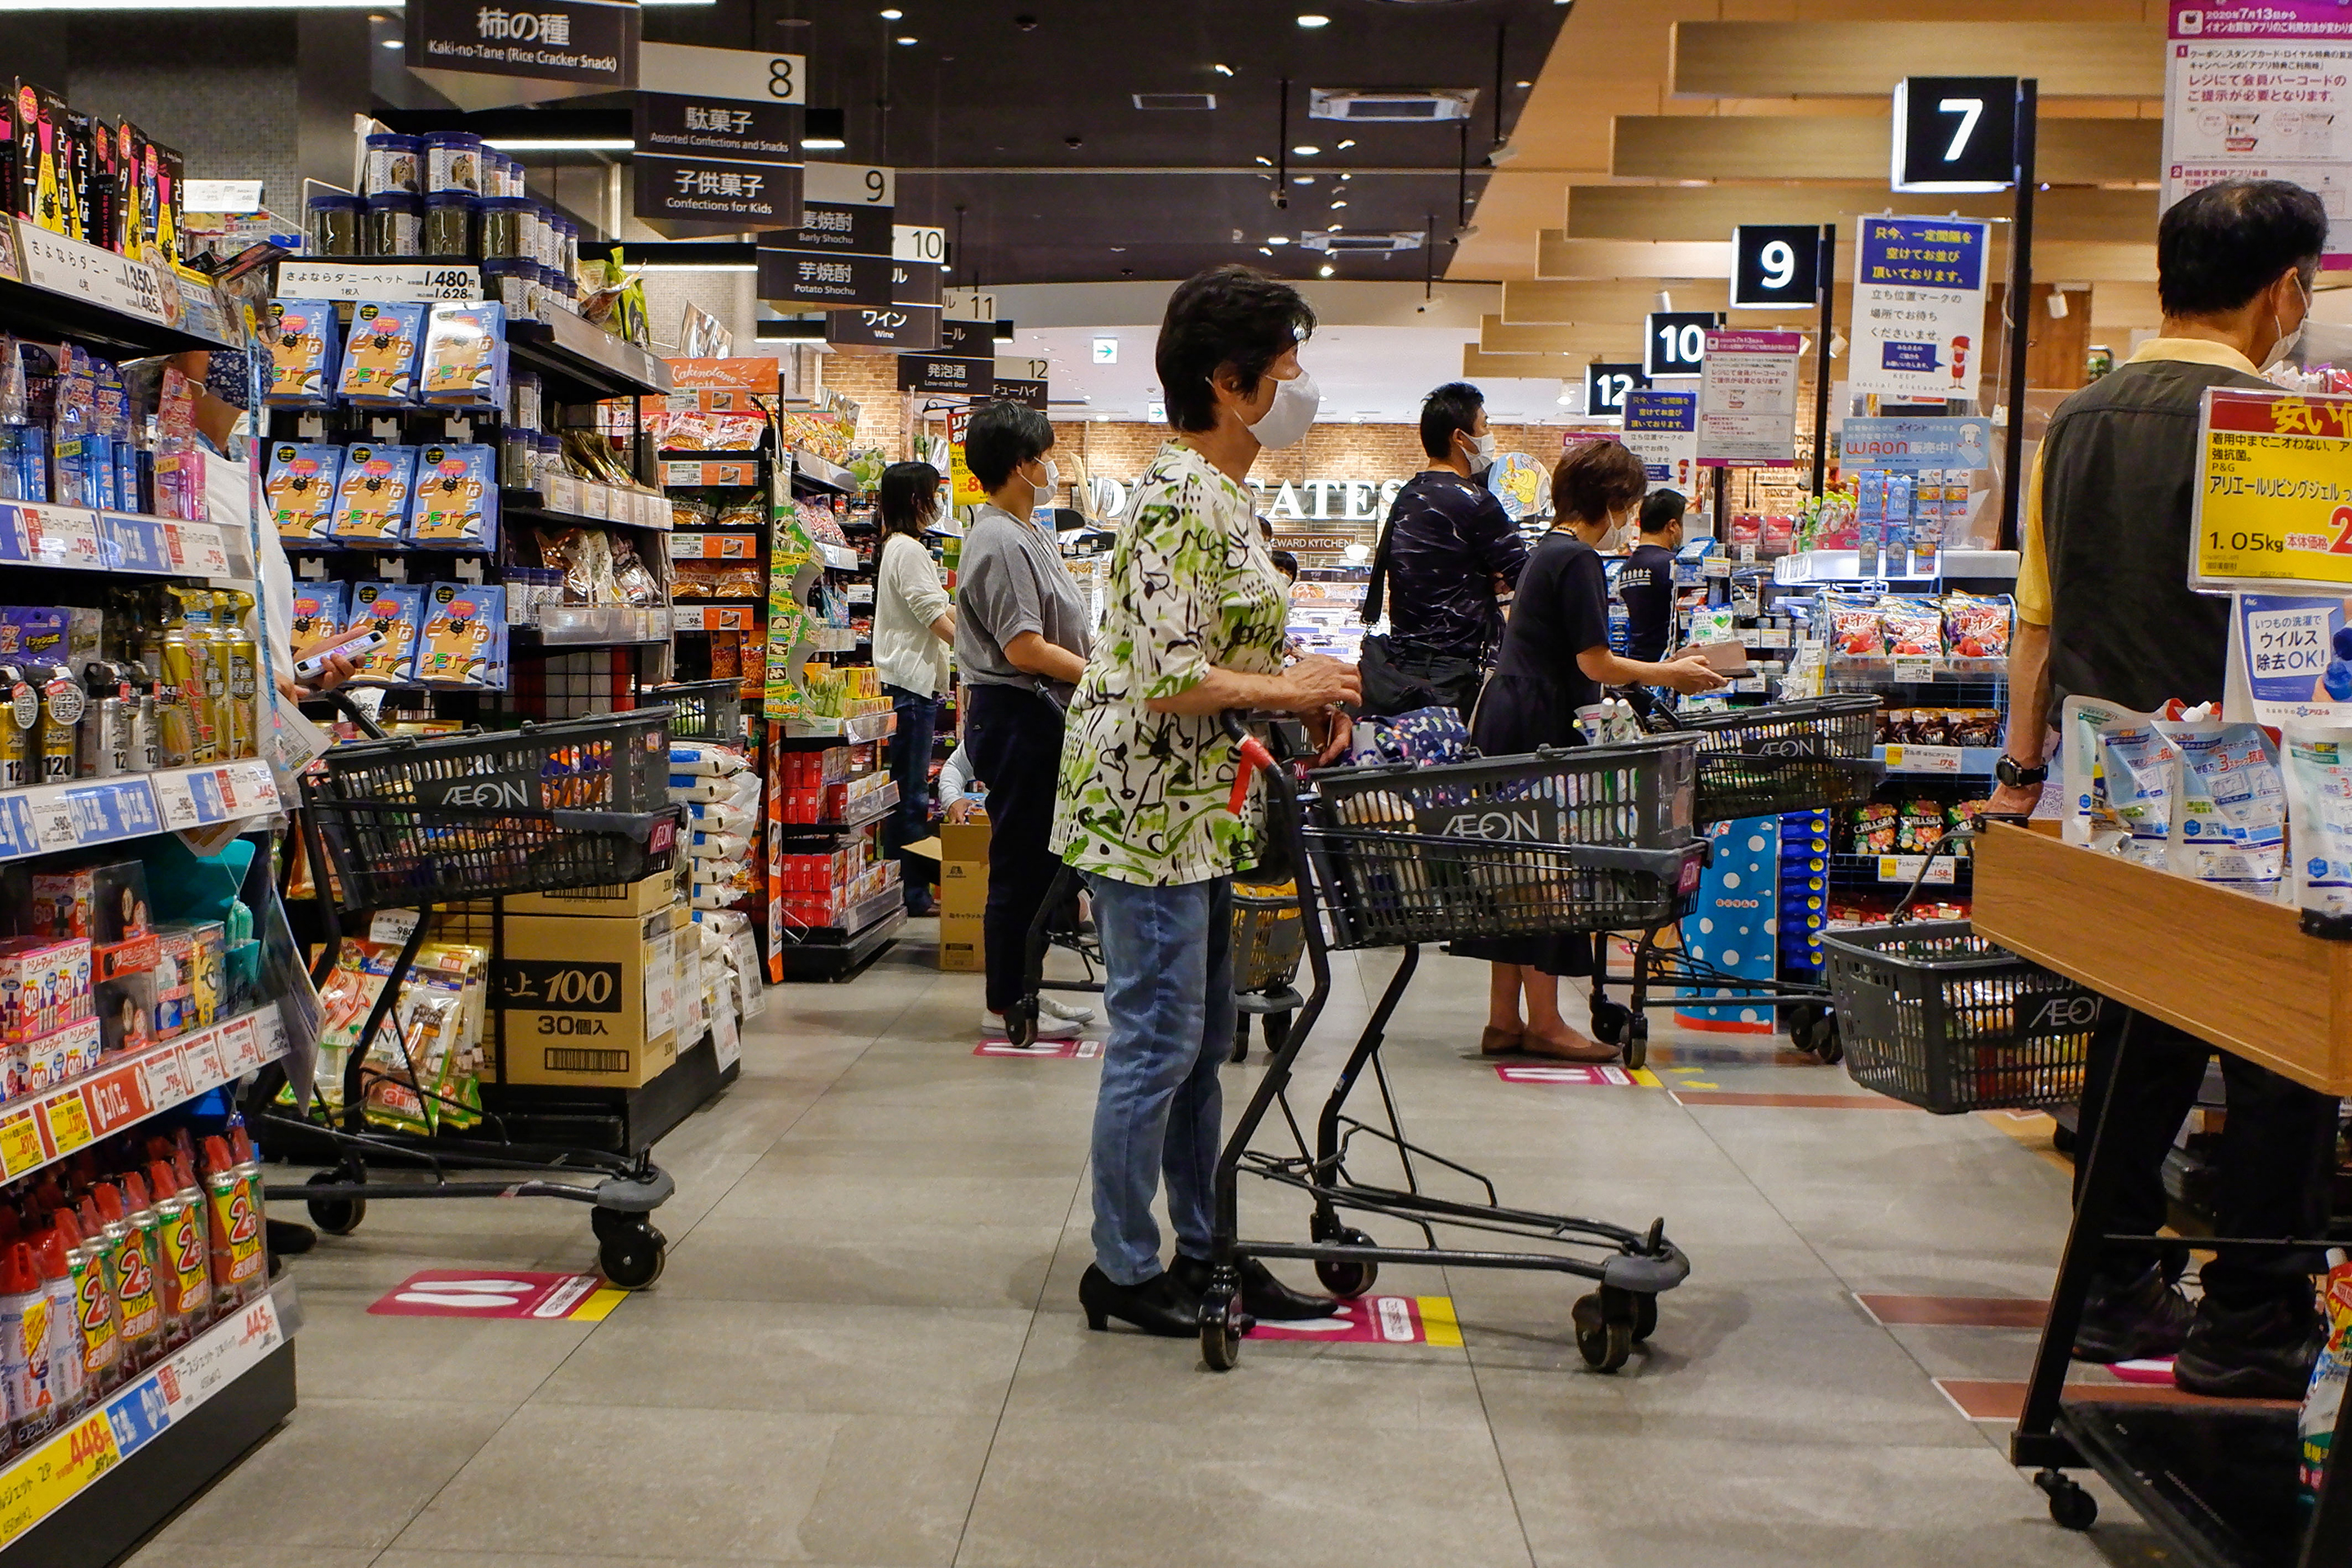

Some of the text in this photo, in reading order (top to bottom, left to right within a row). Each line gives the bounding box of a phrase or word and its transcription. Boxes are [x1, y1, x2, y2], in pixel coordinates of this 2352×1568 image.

[477, 7, 570, 46] 柿の種
[428, 39, 617, 73] Kaki-no-Tane (Rice Cracker Snack)
[768, 58, 794, 98] 8
[2189, 74, 2347, 87] レジにて会員バーコードの
[685, 107, 753, 135] 駄菓子
[1939, 98, 1984, 162] 7
[650, 131, 789, 154] Assorted Confections and Snacks
[675, 170, 764, 198] 子供菓子
[866, 170, 885, 202] 9
[666, 196, 773, 215] Confections for Kids
[804, 210, 853, 232] 麦焼酎
[822, 234, 853, 244] Shochu
[912, 230, 942, 259] 10
[1761, 240, 1795, 289] 9
[1886, 247, 1961, 262] 空けてお並び
[286, 271, 404, 284] さよならダニーペット
[798, 262, 852, 283] 芋焼酎
[1873, 266, 1963, 283] 頂いております。
[794, 284, 856, 296] Potato Shochu
[1872, 289, 1962, 303] 立ち位置マークの
[971, 296, 992, 319] 11
[1870, 308, 1938, 322] 場所でお待ち
[862, 310, 906, 327] ワイン
[395, 314, 415, 369] さよなら
[874, 330, 894, 338] Wine
[1659, 325, 1704, 363] 10
[1870, 327, 1942, 341] くださいませ。
[343, 367, 385, 383] PET
[427, 364, 468, 381] PET
[928, 363, 966, 380] 発泡酒
[1028, 359, 1048, 379] 12
[994, 384, 1038, 398] チューハイ
[1596, 374, 1634, 407] 12
[1846, 441, 1908, 455] WAON
[2212, 449, 2252, 462] 強抗菌。
[2212, 462, 2234, 472] P&G
[315, 456, 333, 512] さよなら
[345, 469, 361, 509] ダニー
[387, 457, 408, 511] さよなら
[421, 470, 438, 510] ダニー
[465, 455, 483, 510] さよなら
[2210, 475, 2339, 501] アリエールリビングジェル
[336, 510, 379, 525] PET
[416, 510, 457, 527] PET
[2287, 534, 2328, 550] 本体価格
[318, 595, 335, 639] さよな
[471, 598, 490, 654] さよなら
[2256, 615, 2322, 629] いつもの洗濯で
[427, 608, 445, 652] ダニー
[2261, 630, 2318, 648] ウイルス
[420, 652, 462, 669] PET
[2256, 649, 2325, 671] 除去OK!
[1854, 817, 1896, 835] CHELSEA
[538, 1015, 608, 1036] 30個入
